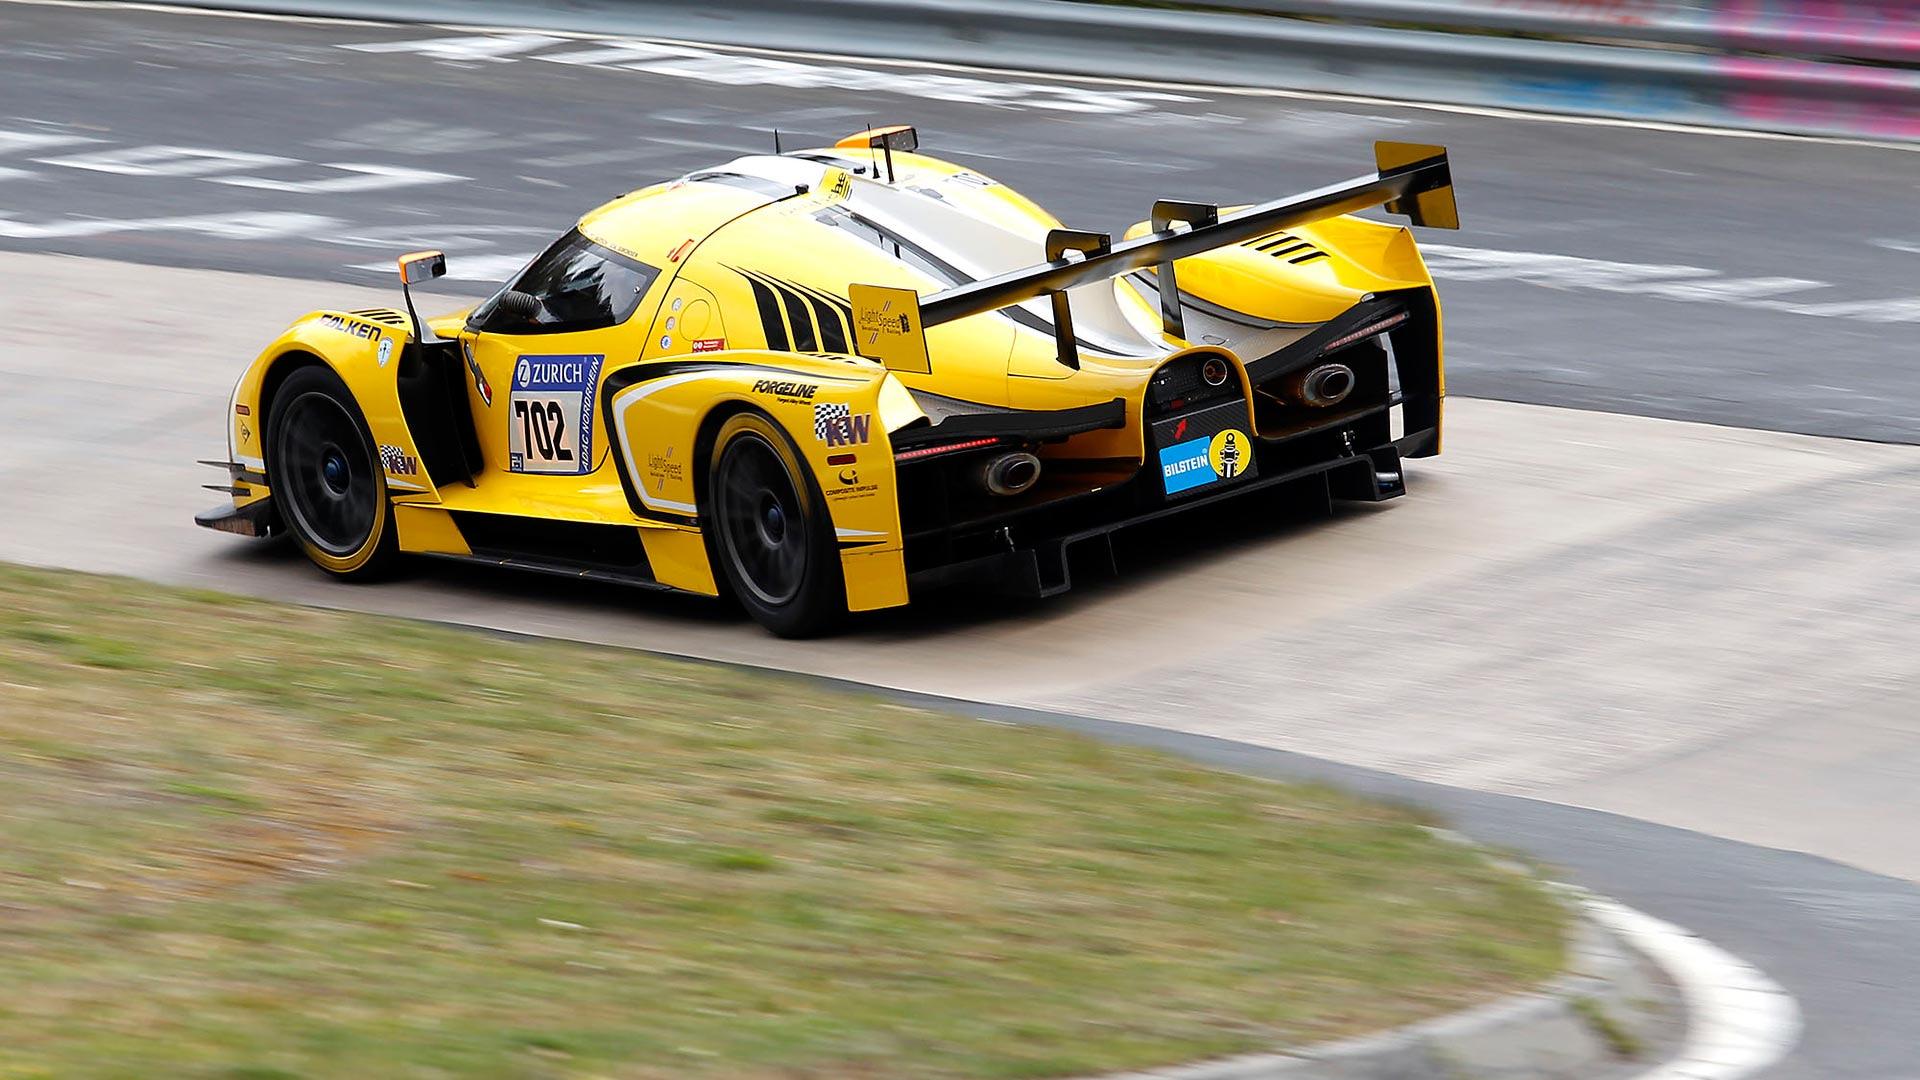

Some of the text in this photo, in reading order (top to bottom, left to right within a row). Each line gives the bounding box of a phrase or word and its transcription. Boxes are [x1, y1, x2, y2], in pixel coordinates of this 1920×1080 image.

[318, 314, 382, 341] FALKEN
[532, 363, 583, 383] ZURICH
[751, 379, 819, 399] FORGELINE
[581, 356, 600, 471] ADAC NORDRHEIN
[513, 400, 574, 460] 702
[824, 413, 871, 447] KW
[389, 455, 417, 475] KW
[1163, 454, 1209, 477] BILSTEIN
